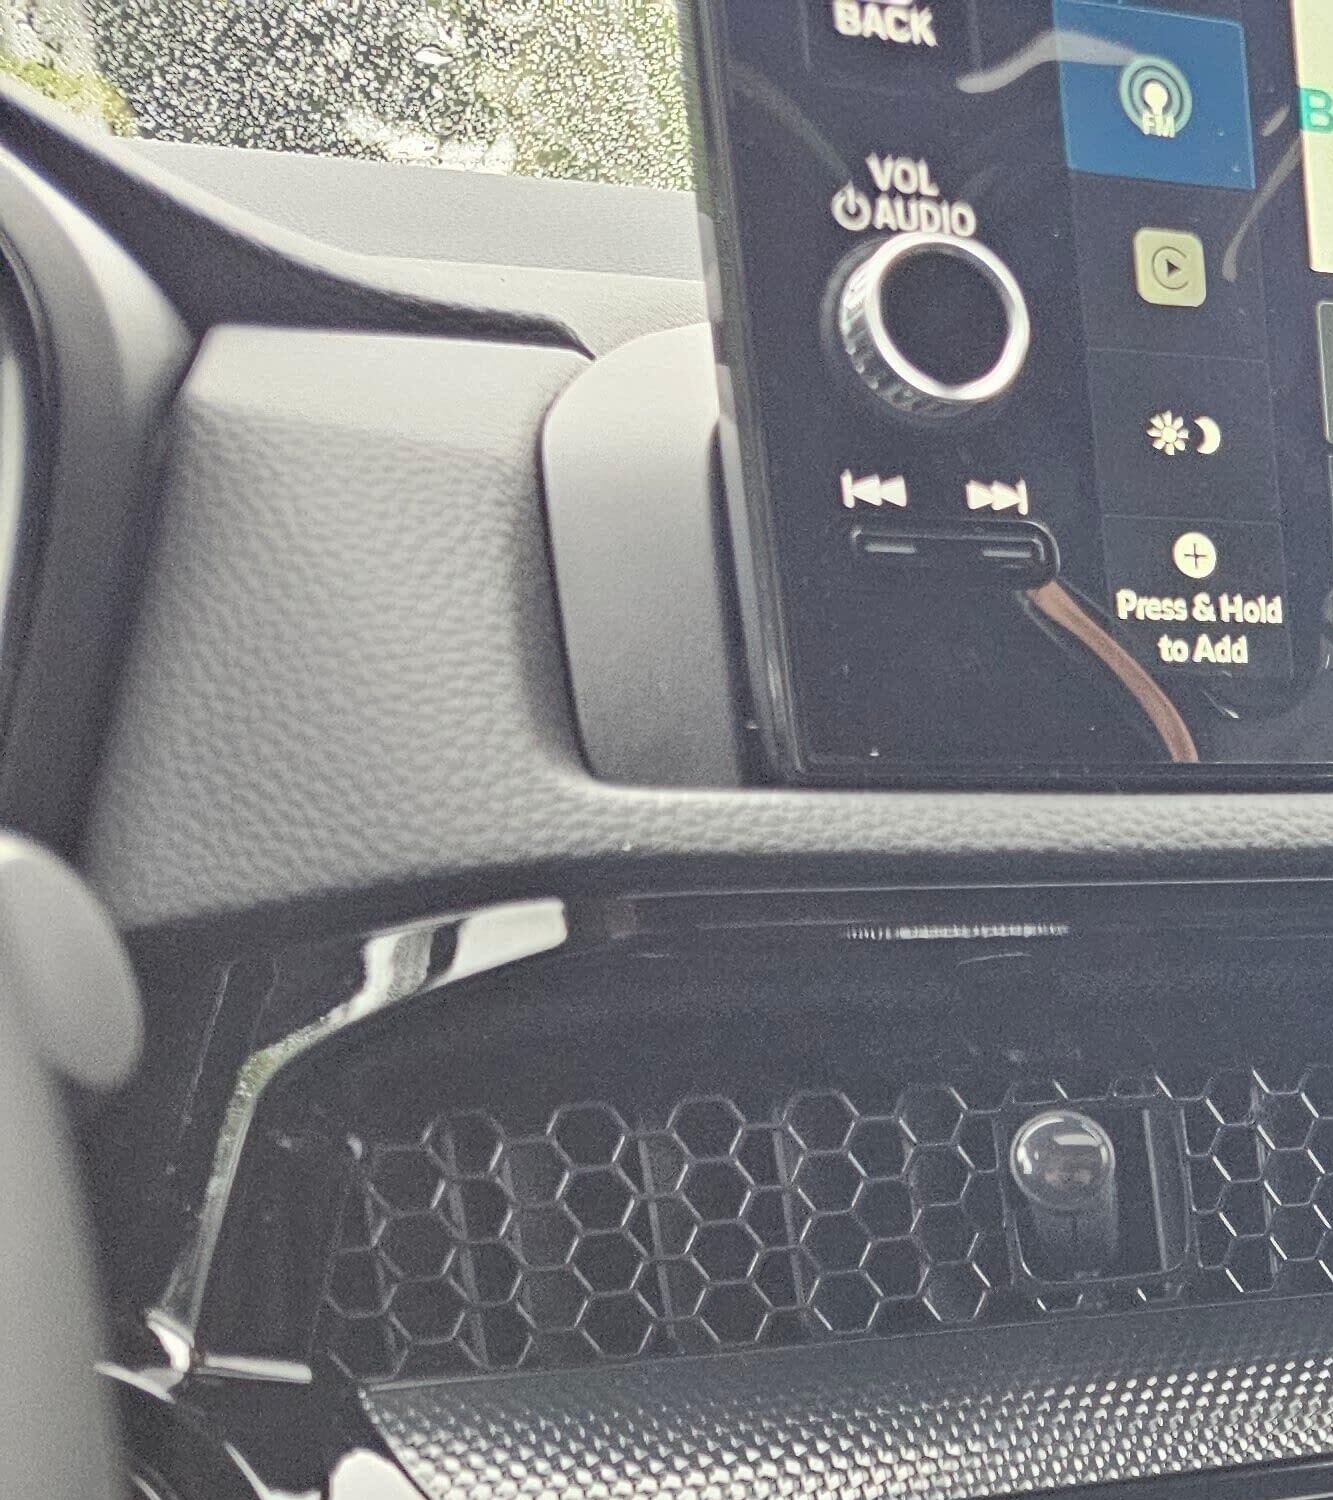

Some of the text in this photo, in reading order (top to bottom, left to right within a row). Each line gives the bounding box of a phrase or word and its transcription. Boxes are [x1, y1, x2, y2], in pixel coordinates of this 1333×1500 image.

[833, 0, 938, 47] BACK
[865, 152, 940, 197] VOL
[873, 195, 977, 237] AUDIO
[1115, 589, 1283, 625] Press & Hold
[1157, 634, 1248, 665] to Add
